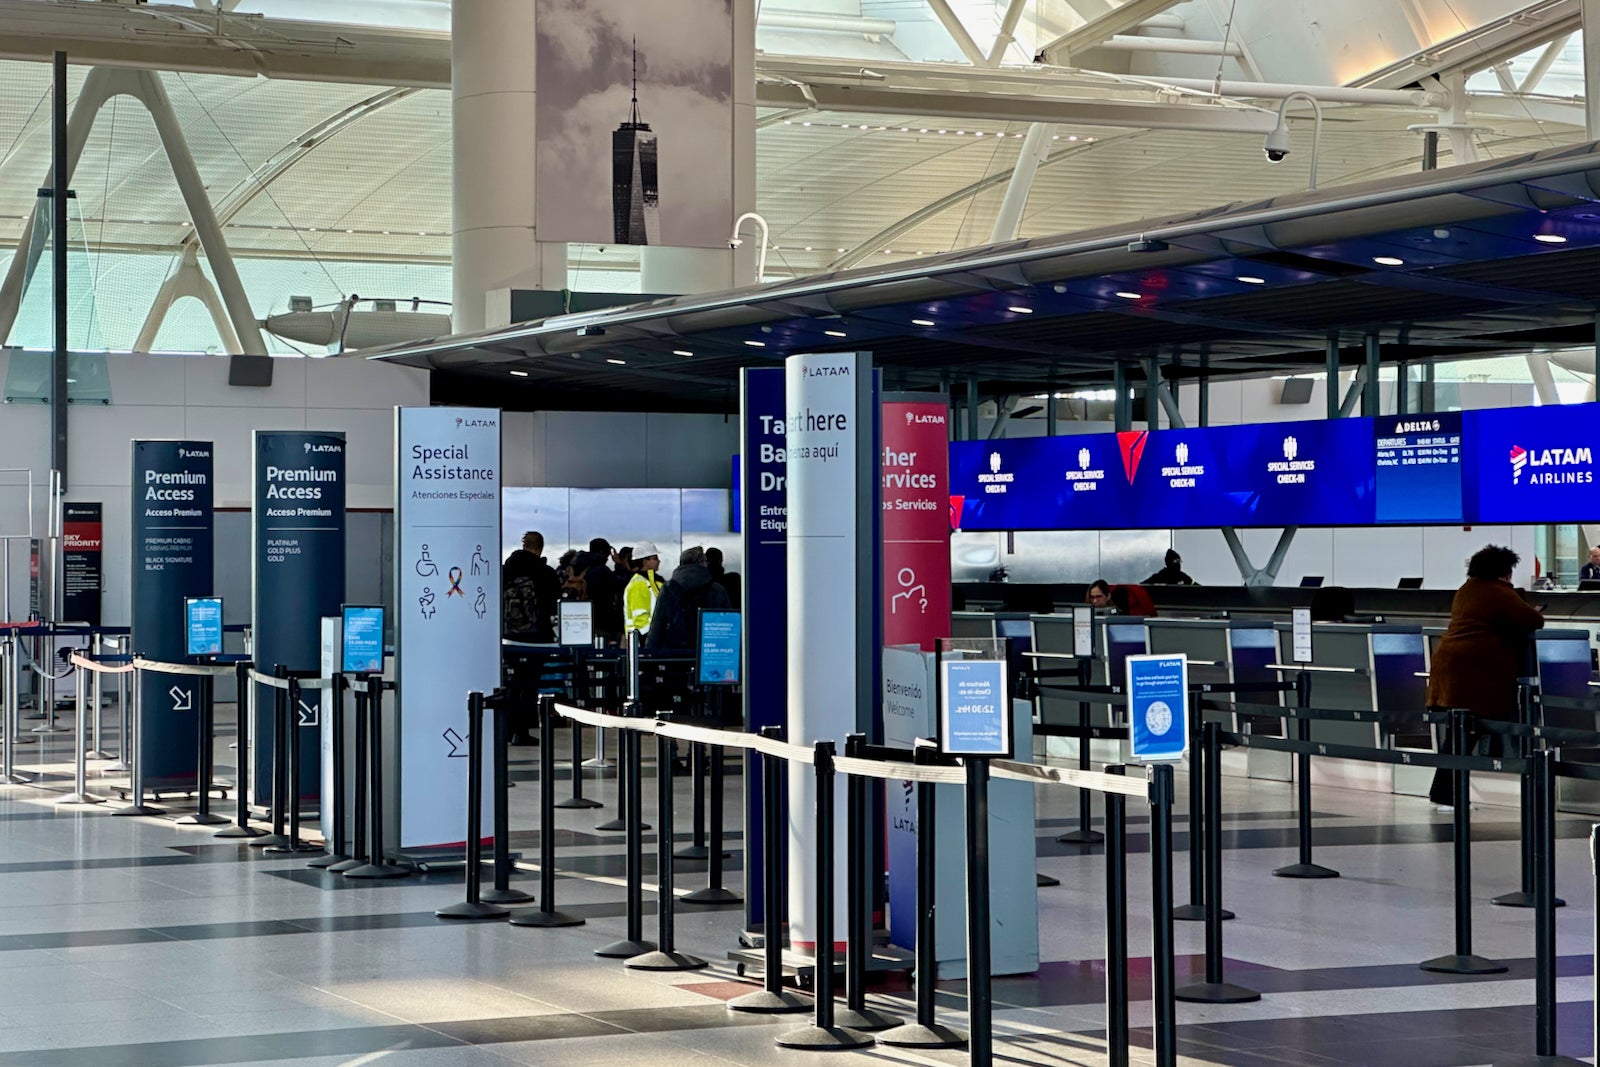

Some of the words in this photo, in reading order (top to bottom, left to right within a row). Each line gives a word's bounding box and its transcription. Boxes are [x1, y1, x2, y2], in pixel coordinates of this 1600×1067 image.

[810, 366, 850, 377] LATAM
[807, 408, 846, 431] here
[915, 414, 945, 424] LATAM
[760, 415, 787, 438] Ta
[1404, 421, 1432, 432] DELTA
[412, 444, 469, 464] Special
[760, 444, 787, 463] Ba
[813, 442, 839, 463] aquí
[1530, 447, 1593, 467] LATAM
[412, 465, 494, 480] Assistance
[1161, 467, 1180, 476] SPECIAL
[1180, 465, 1204, 475] SERVICES
[1267, 462, 1289, 472] SPECIAL
[1289, 460, 1315, 471] SERVICES
[145, 469, 206, 484] Premium
[266, 466, 337, 481] Premium
[978, 474, 994, 483] SPECIAL
[994, 473, 1014, 482] SERVICES
[1066, 471, 1083, 480] SPECIAL
[1083, 470, 1104, 479] SERVICES
[1277, 473, 1305, 484] CHECK-IN
[1530, 471, 1593, 484] AIRLINES
[985, 484, 1006, 493] CHECK-IN
[1073, 482, 1096, 491] CHECK-IN
[1170, 478, 1195, 487] CHECK-IN
[145, 486, 195, 501] Access
[266, 484, 322, 499] Access
[412, 491, 458, 499] Atenciones
[459, 491, 495, 501] Especiales
[760, 506, 787, 516] Entre
[895, 498, 938, 511] Servicios
[145, 508, 173, 517] Acceso
[173, 508, 203, 517] Premium
[266, 508, 296, 517] Acceso
[297, 507, 332, 517] Premium
[760, 519, 787, 532] Etiqu
[887, 679, 922, 699] Bienvenido
[887, 699, 914, 719] Welcome
[893, 815, 916, 834] LATA
